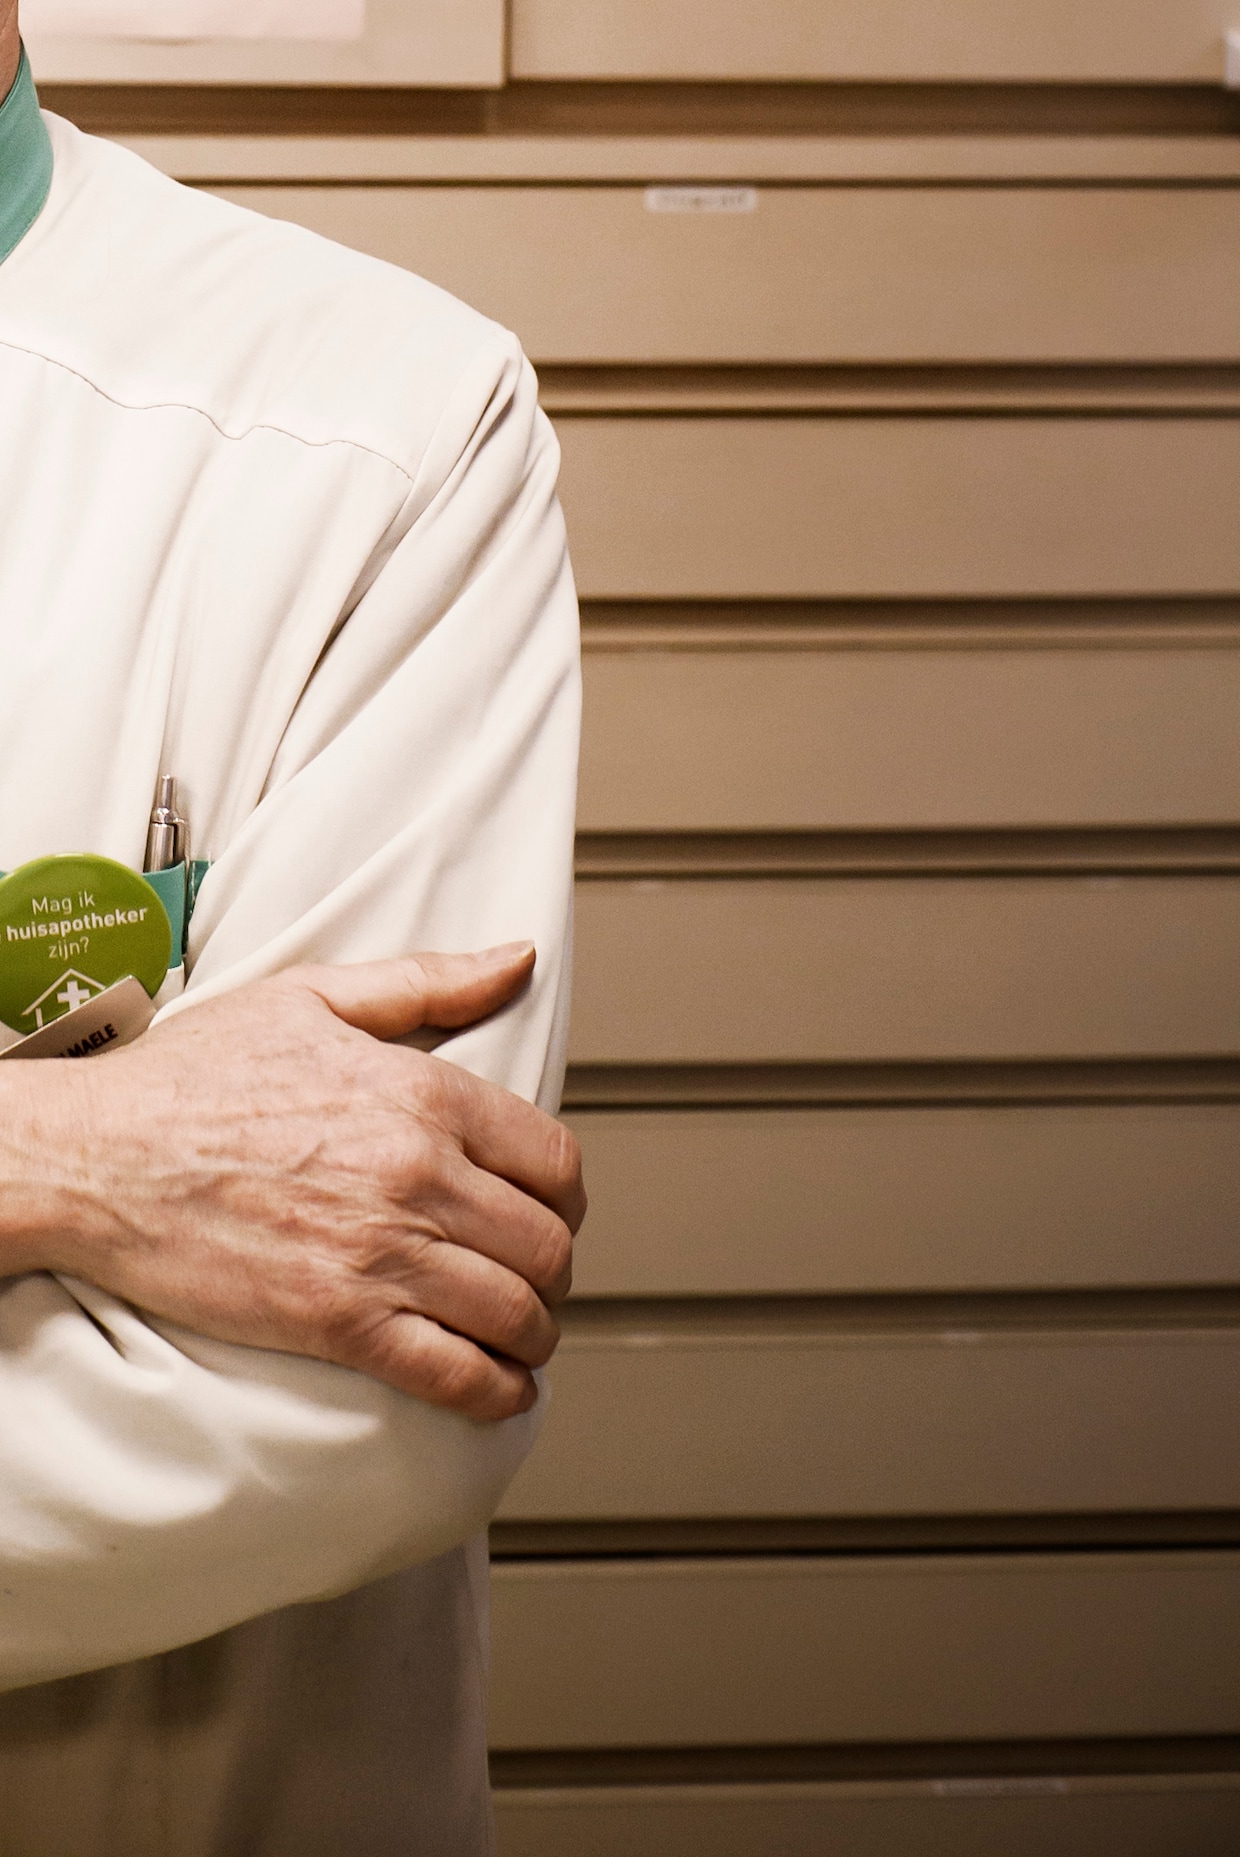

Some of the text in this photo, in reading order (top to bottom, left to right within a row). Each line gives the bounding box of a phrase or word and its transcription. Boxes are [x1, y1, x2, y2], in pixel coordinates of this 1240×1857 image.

[31, 890, 96, 916] Mag ik
[6, 906, 149, 942] huisapotheker
[48, 936, 90, 961] zijn?
